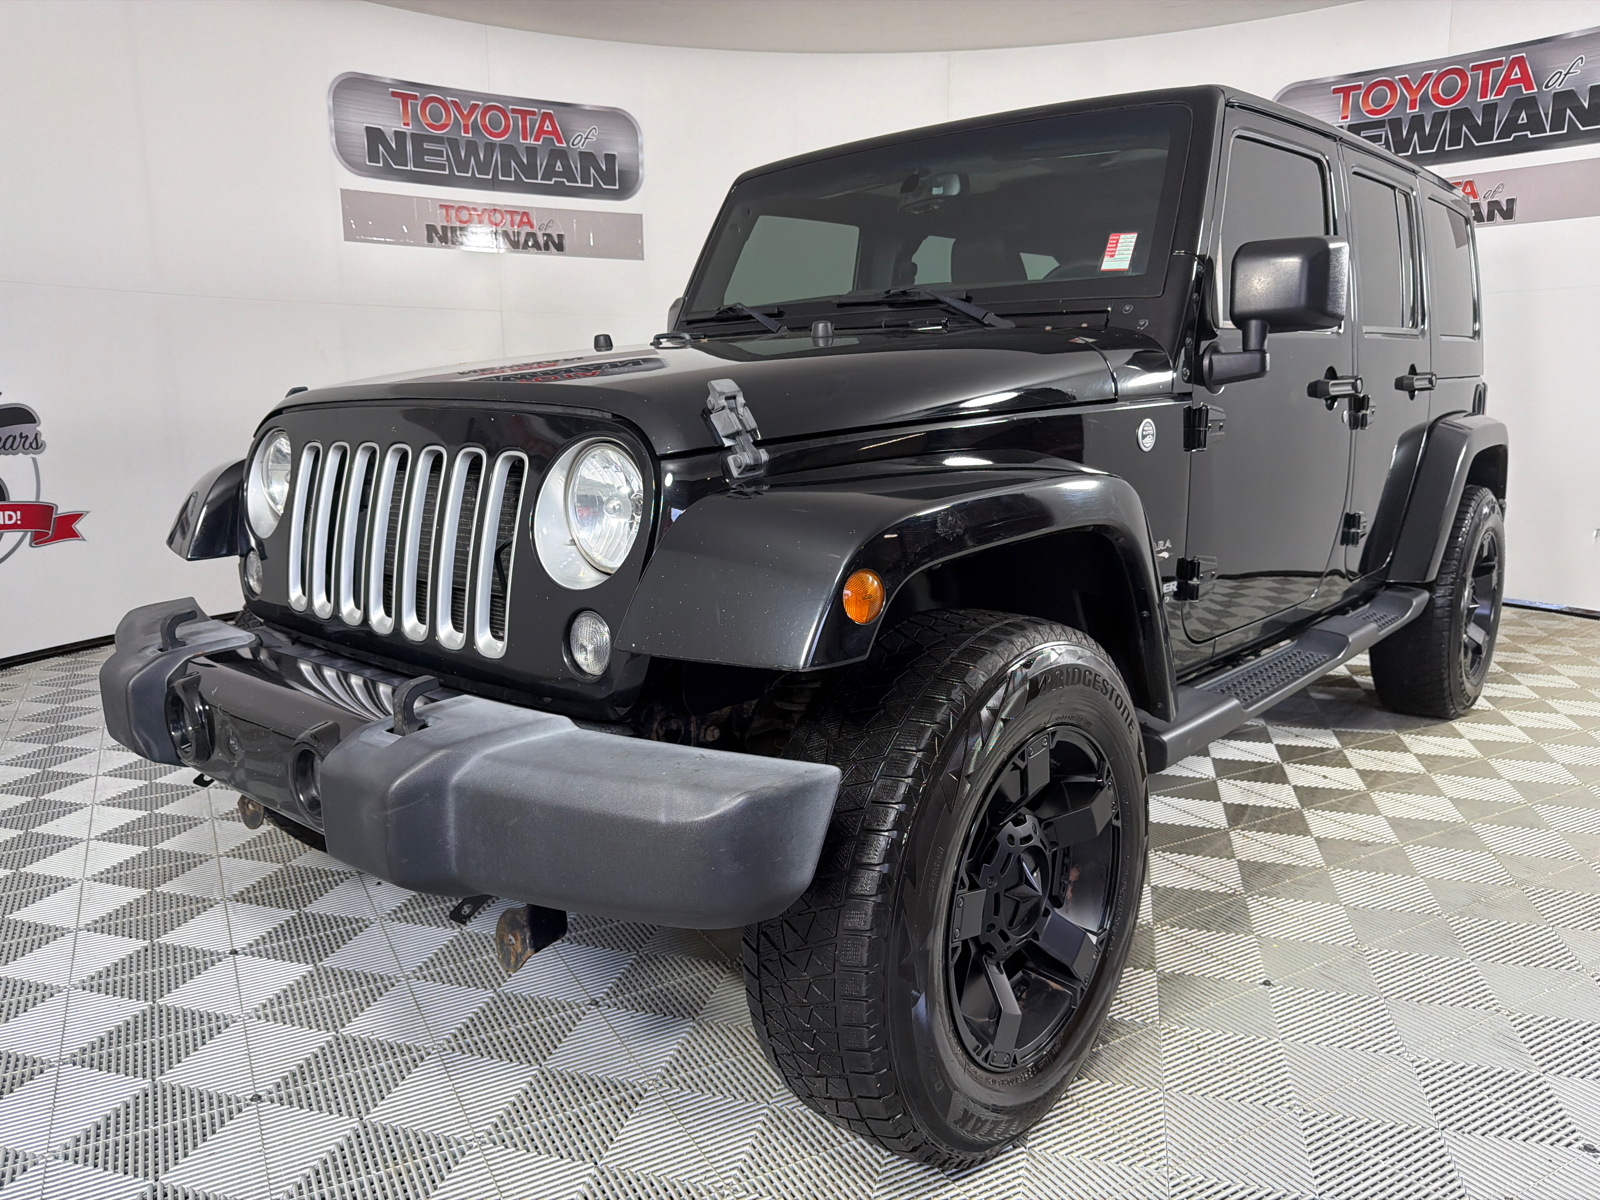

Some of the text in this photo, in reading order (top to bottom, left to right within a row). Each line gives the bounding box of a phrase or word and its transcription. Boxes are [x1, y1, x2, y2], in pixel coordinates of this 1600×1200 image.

[389, 88, 598, 149] TOYOTA of
[1331, 53, 1585, 122] TOYOTA of
[364, 125, 619, 190] NEWNAN
[439, 204, 534, 230] TOYOTA
